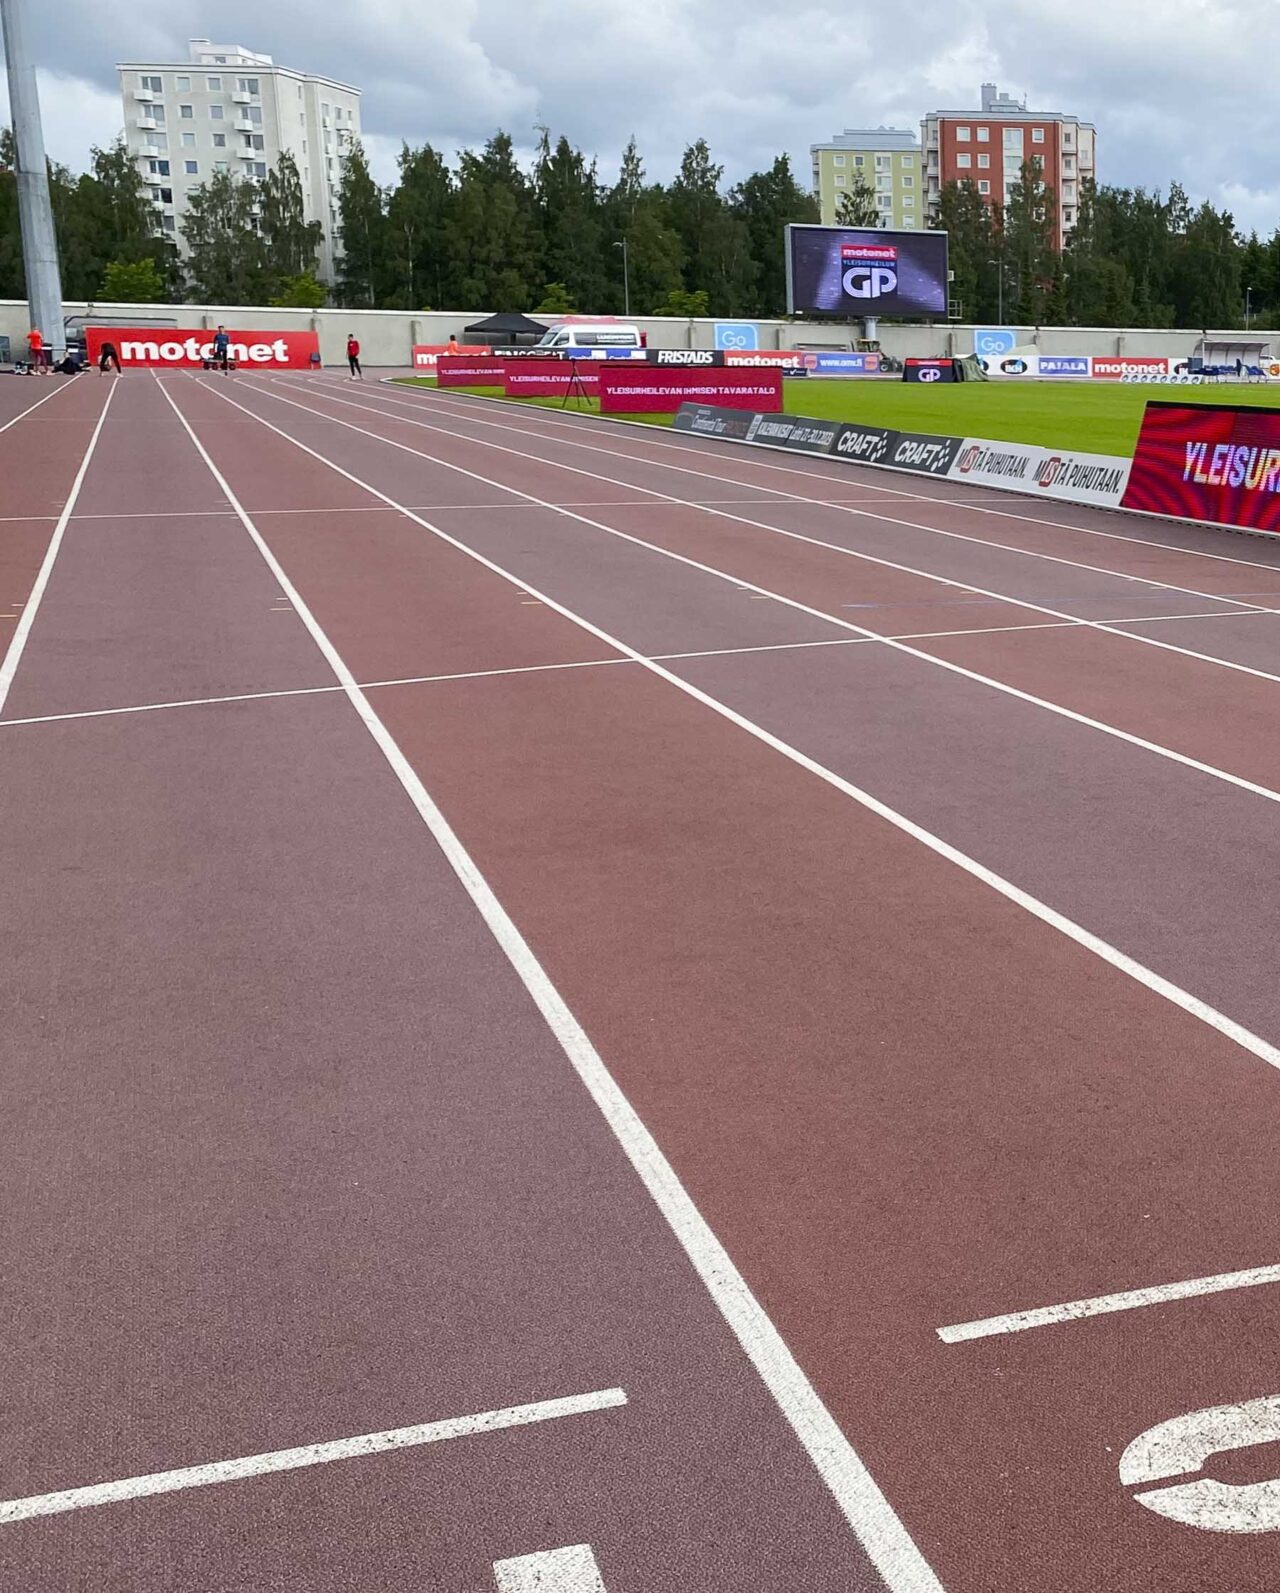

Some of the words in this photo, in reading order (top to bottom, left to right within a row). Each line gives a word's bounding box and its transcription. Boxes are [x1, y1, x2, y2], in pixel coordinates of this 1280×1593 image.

[843, 248, 896, 258] motonet
[843, 267, 897, 299] GP
[722, 331, 746, 346] Go
[981, 337, 1005, 352] Go
[657, 350, 714, 364] FRISTADS
[727, 355, 801, 368] motonet
[1094, 361, 1166, 374] motonet
[606, 387, 683, 395] YLEISURHEILEVAN
[683, 387, 717, 395] IHMISEN
[718, 387, 776, 395] TAVARATALO
[837, 430, 880, 457] CRAFT
[894, 440, 942, 466] CRAFT
[985, 451, 1030, 479] PUHUTAAN.
[1032, 457, 1074, 487] MISTÄ
[1069, 463, 1125, 494] PUHUTAAN.
